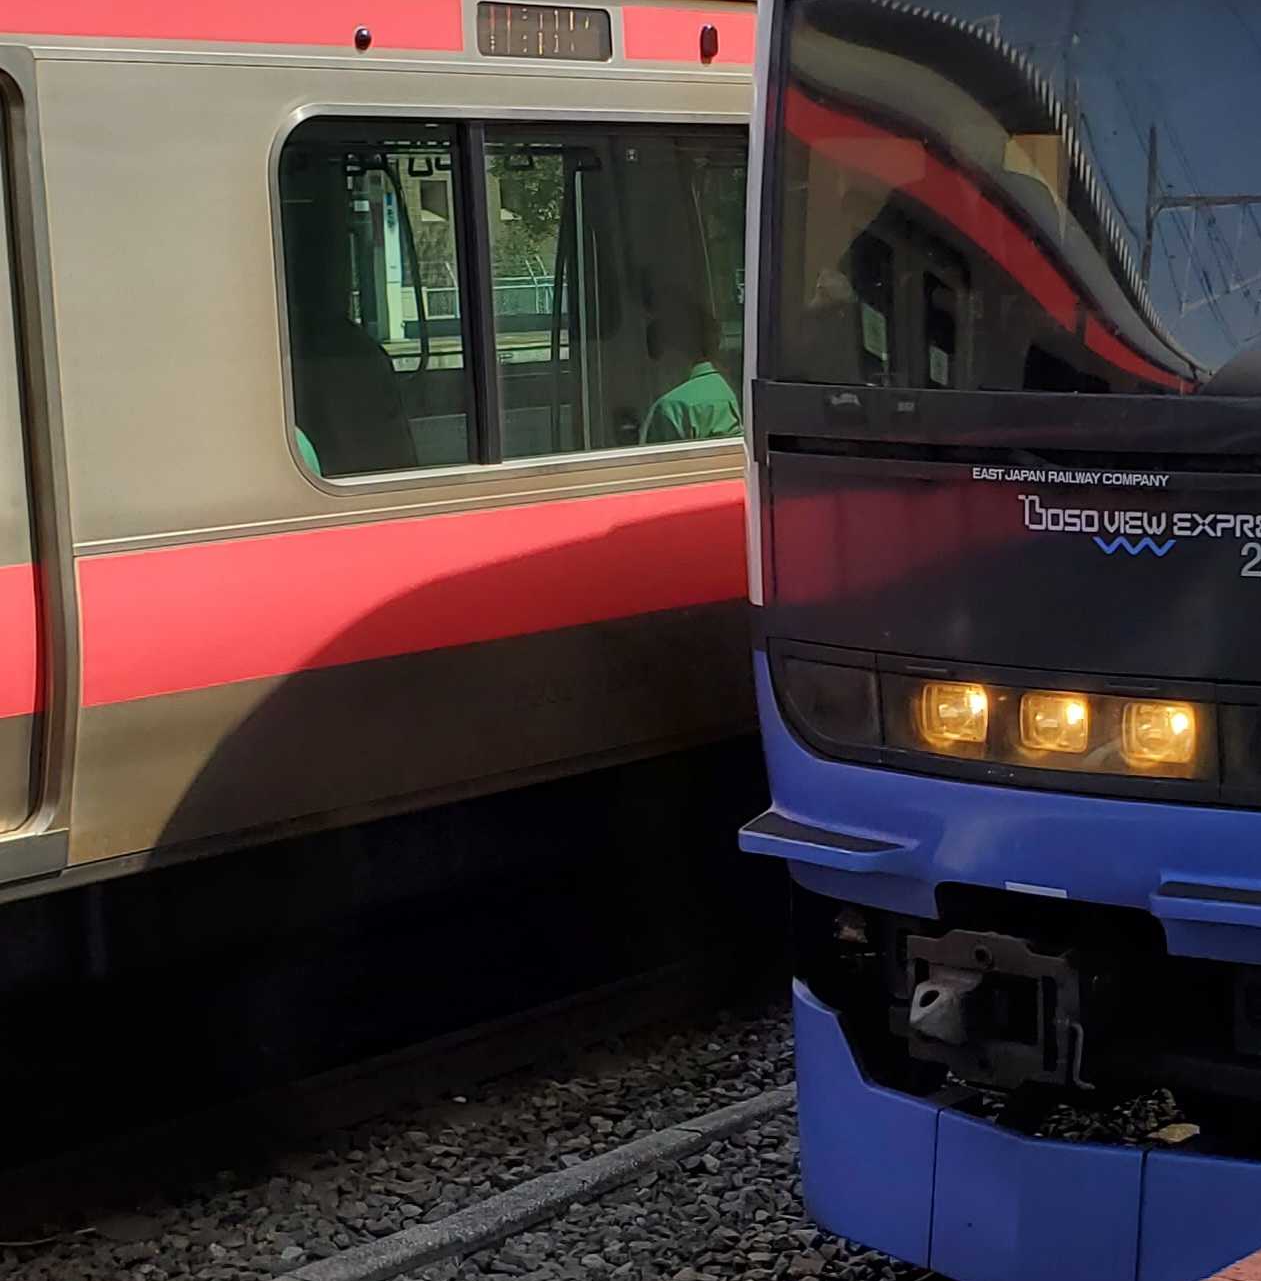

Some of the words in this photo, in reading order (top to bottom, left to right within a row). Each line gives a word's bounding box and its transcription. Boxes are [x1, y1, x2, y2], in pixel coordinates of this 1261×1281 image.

[972, 467, 1004, 481] EAST
[1004, 469, 1046, 482] JAPAN
[1048, 471, 1100, 484] RAILWAY
[1102, 472, 1169, 487] COMPANY
[1018, 494, 1099, 532] BOSO
[1104, 510, 1166, 536] VIEW
